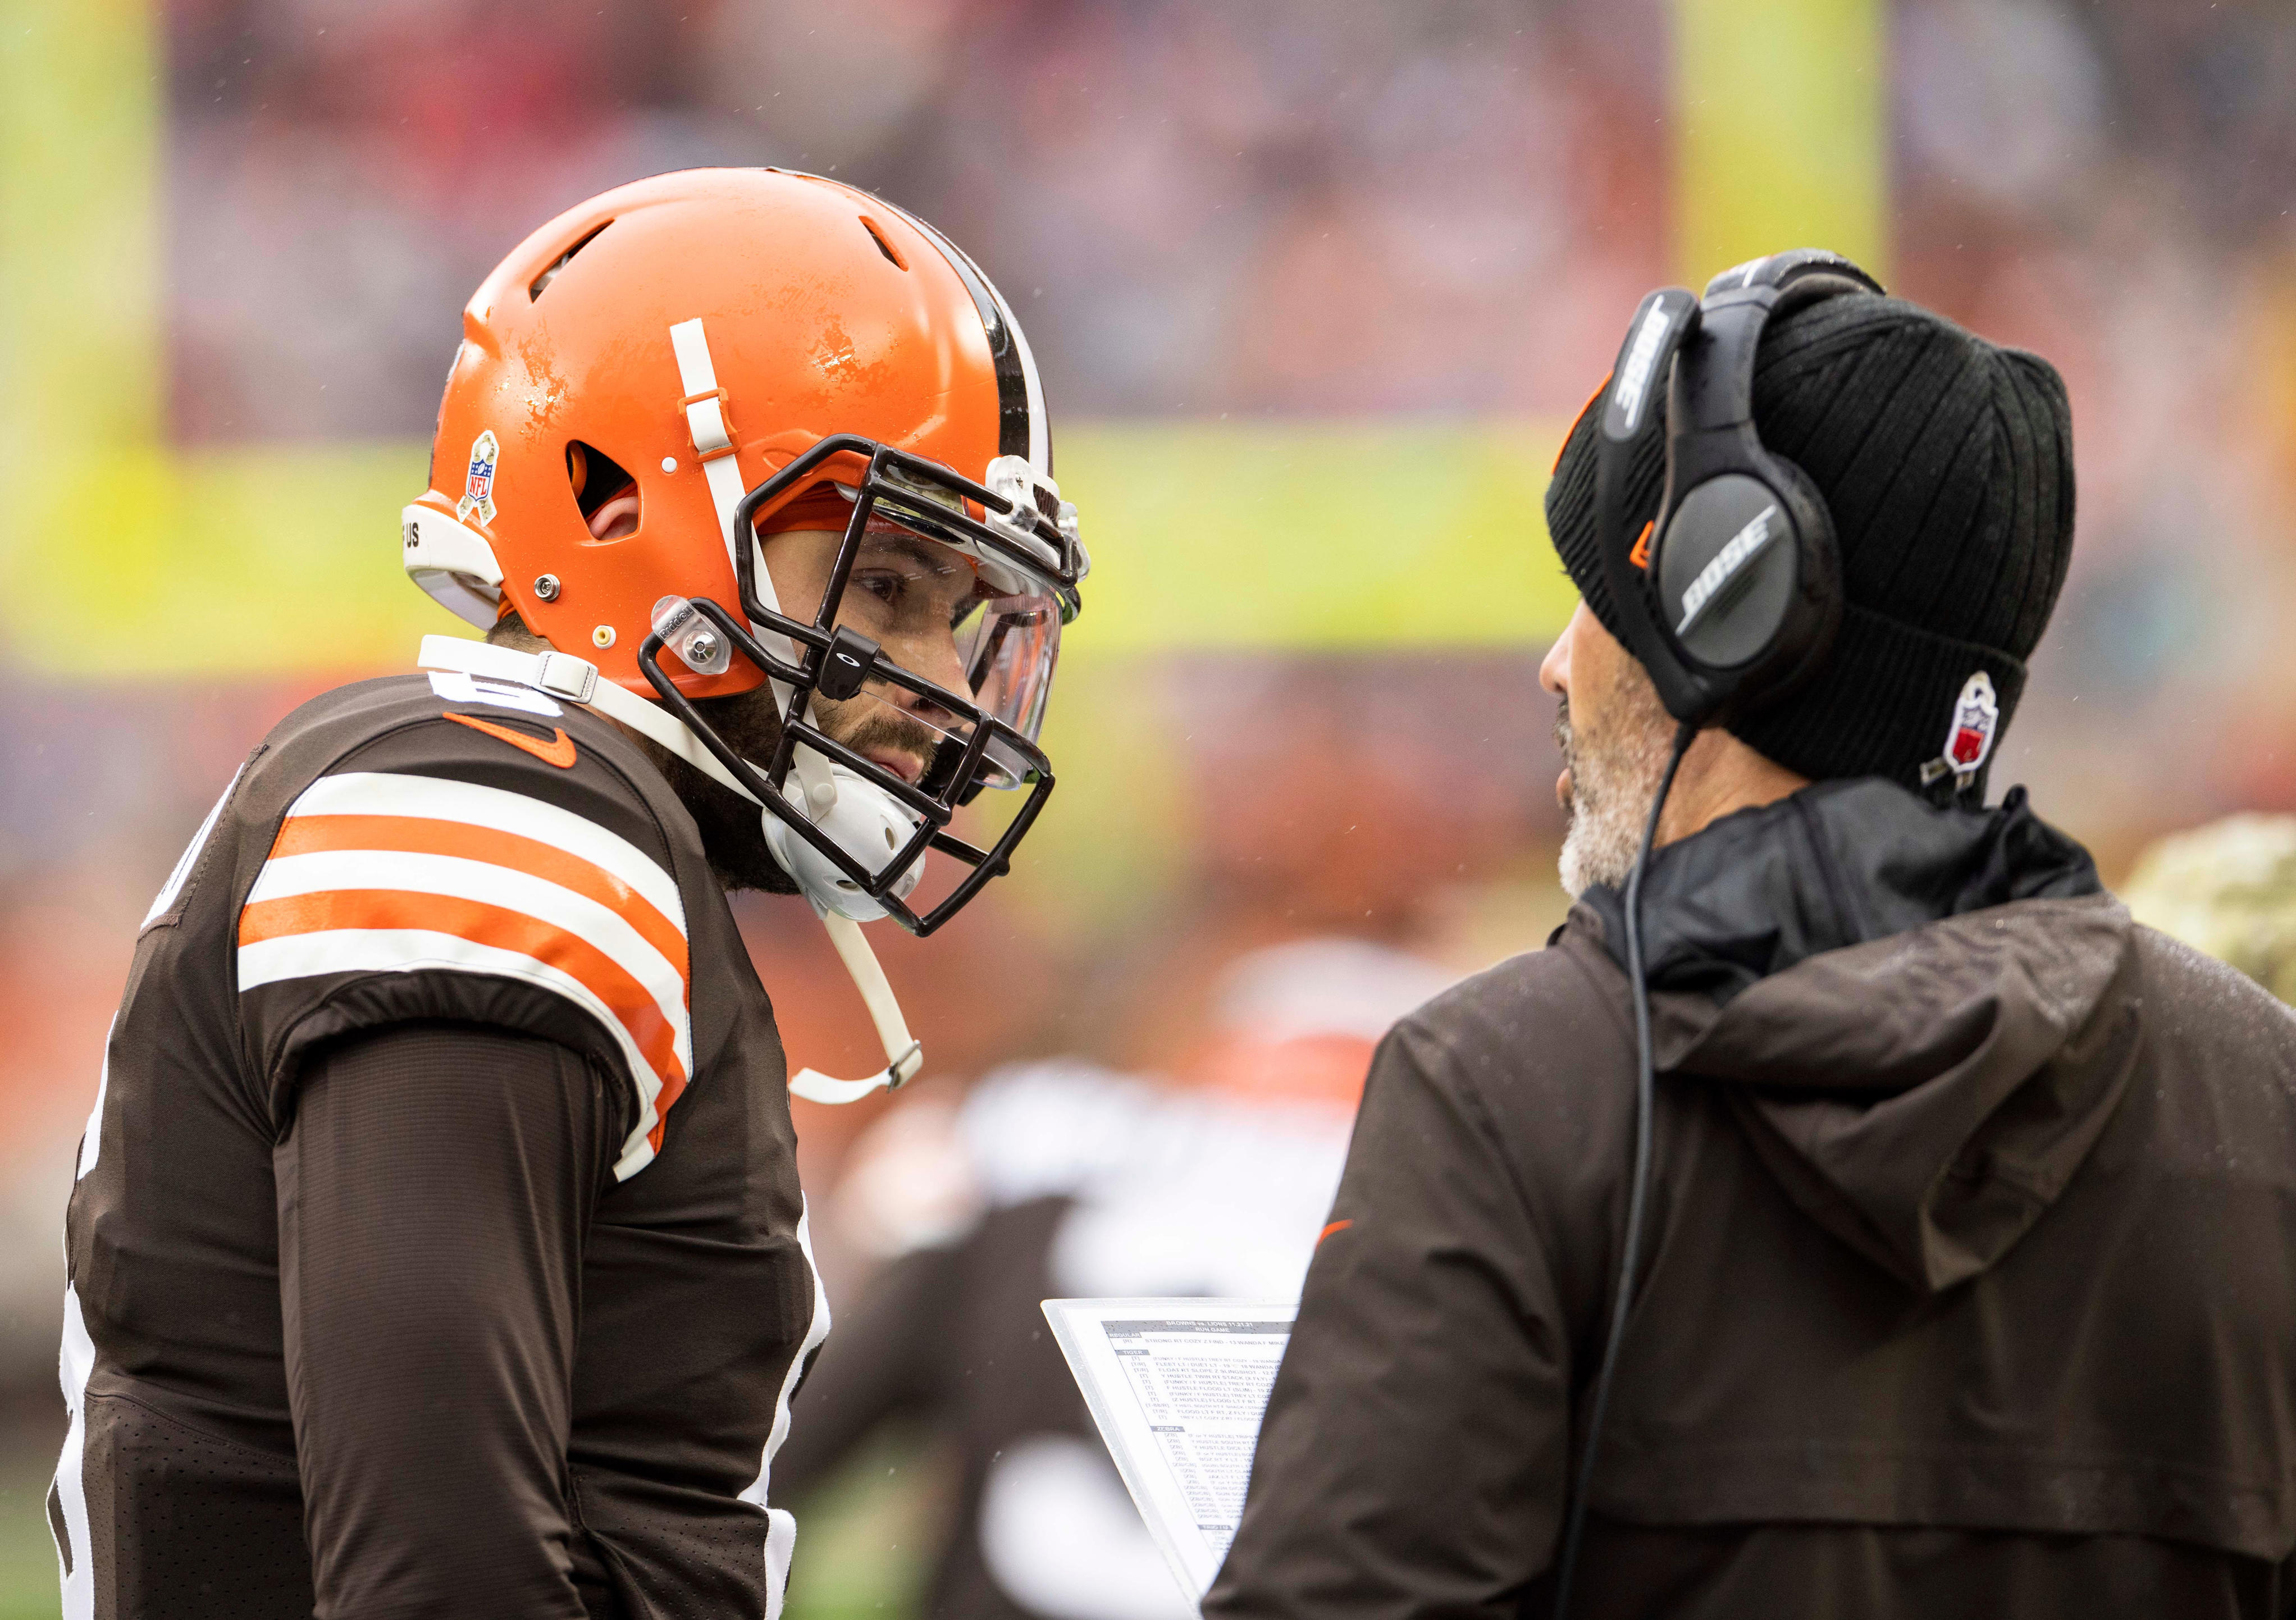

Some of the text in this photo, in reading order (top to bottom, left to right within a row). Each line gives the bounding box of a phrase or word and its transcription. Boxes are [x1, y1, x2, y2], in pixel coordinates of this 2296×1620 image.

[1615, 294, 1670, 428] BOSE
[469, 476, 487, 498] NFL
[403, 522, 419, 548] US
[1674, 504, 1777, 636] BOSE
[658, 605, 694, 641] Riddell
